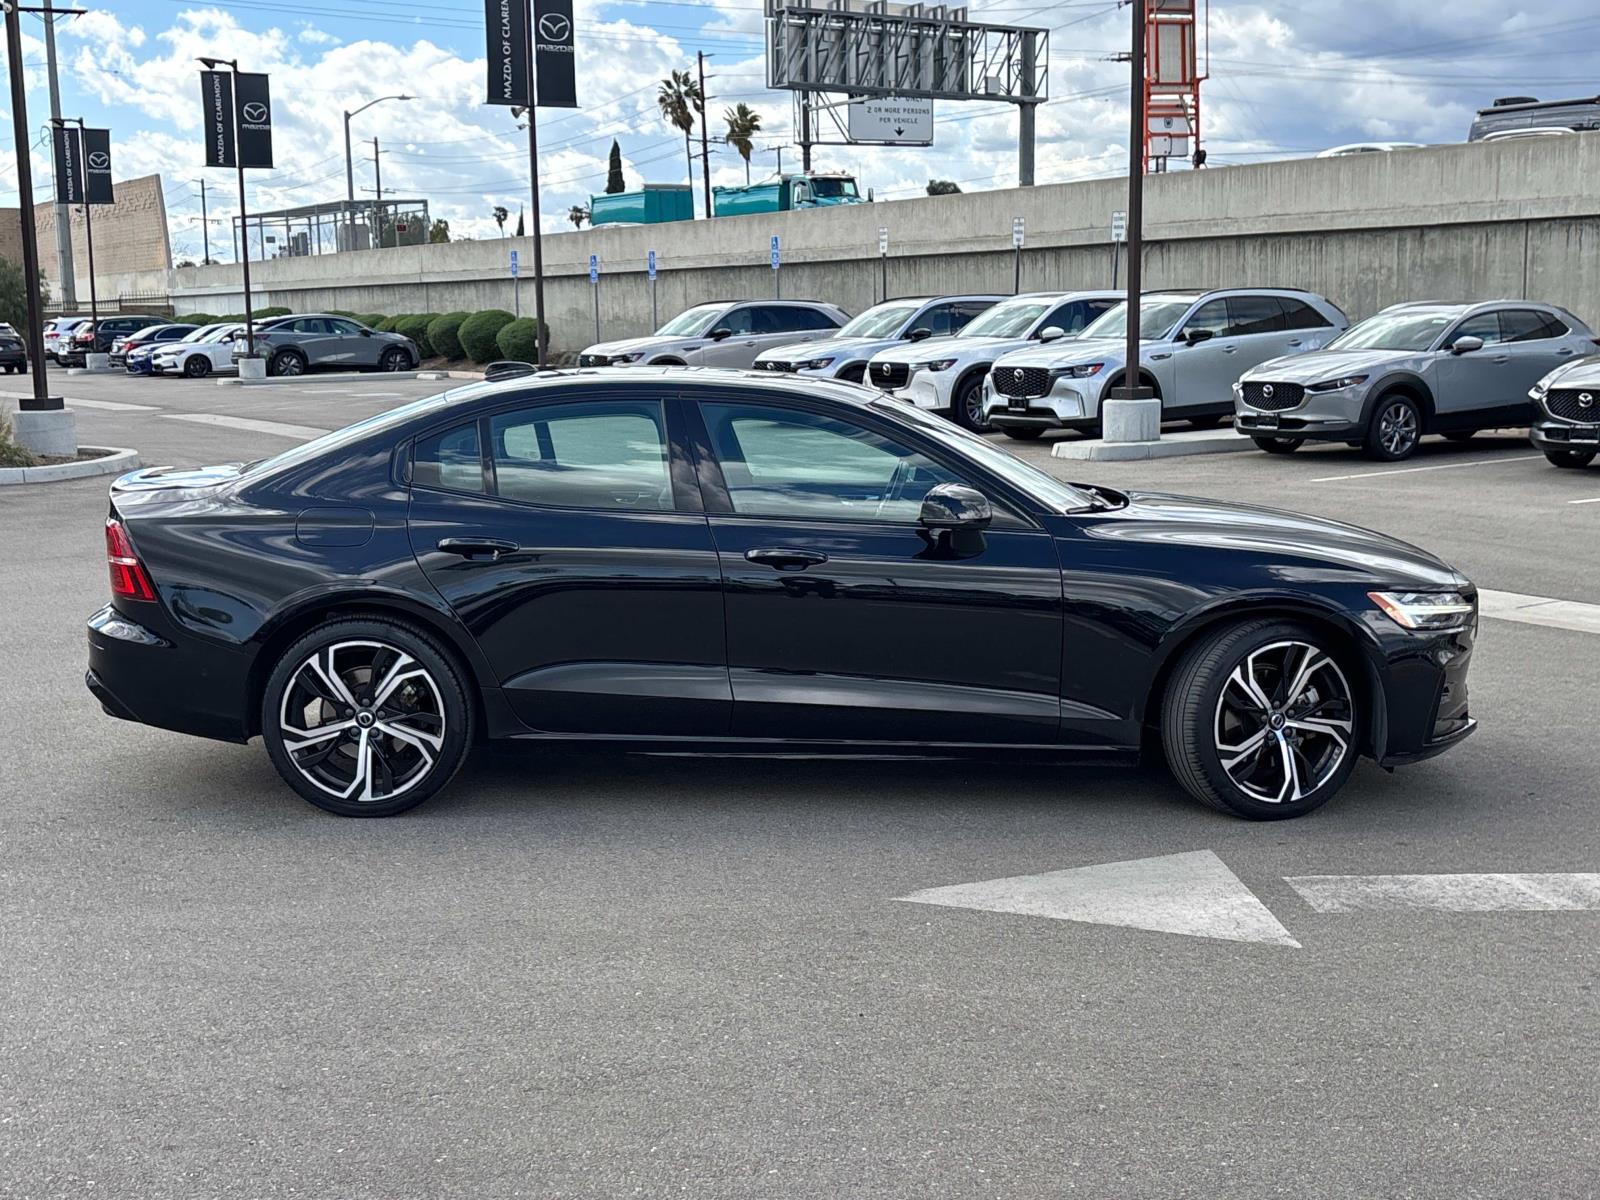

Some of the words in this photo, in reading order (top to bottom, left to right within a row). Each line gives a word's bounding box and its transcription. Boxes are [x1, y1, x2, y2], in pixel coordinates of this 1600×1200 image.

[502, 39, 511, 55] OF
[503, 57, 512, 99] MAZDA
[213, 74, 223, 121] CLAREMONT
[866, 106, 872, 114] 2
[902, 107, 930, 115] PERSONS
[216, 122, 224, 133] OF
[217, 133, 225, 164] MAZDA
